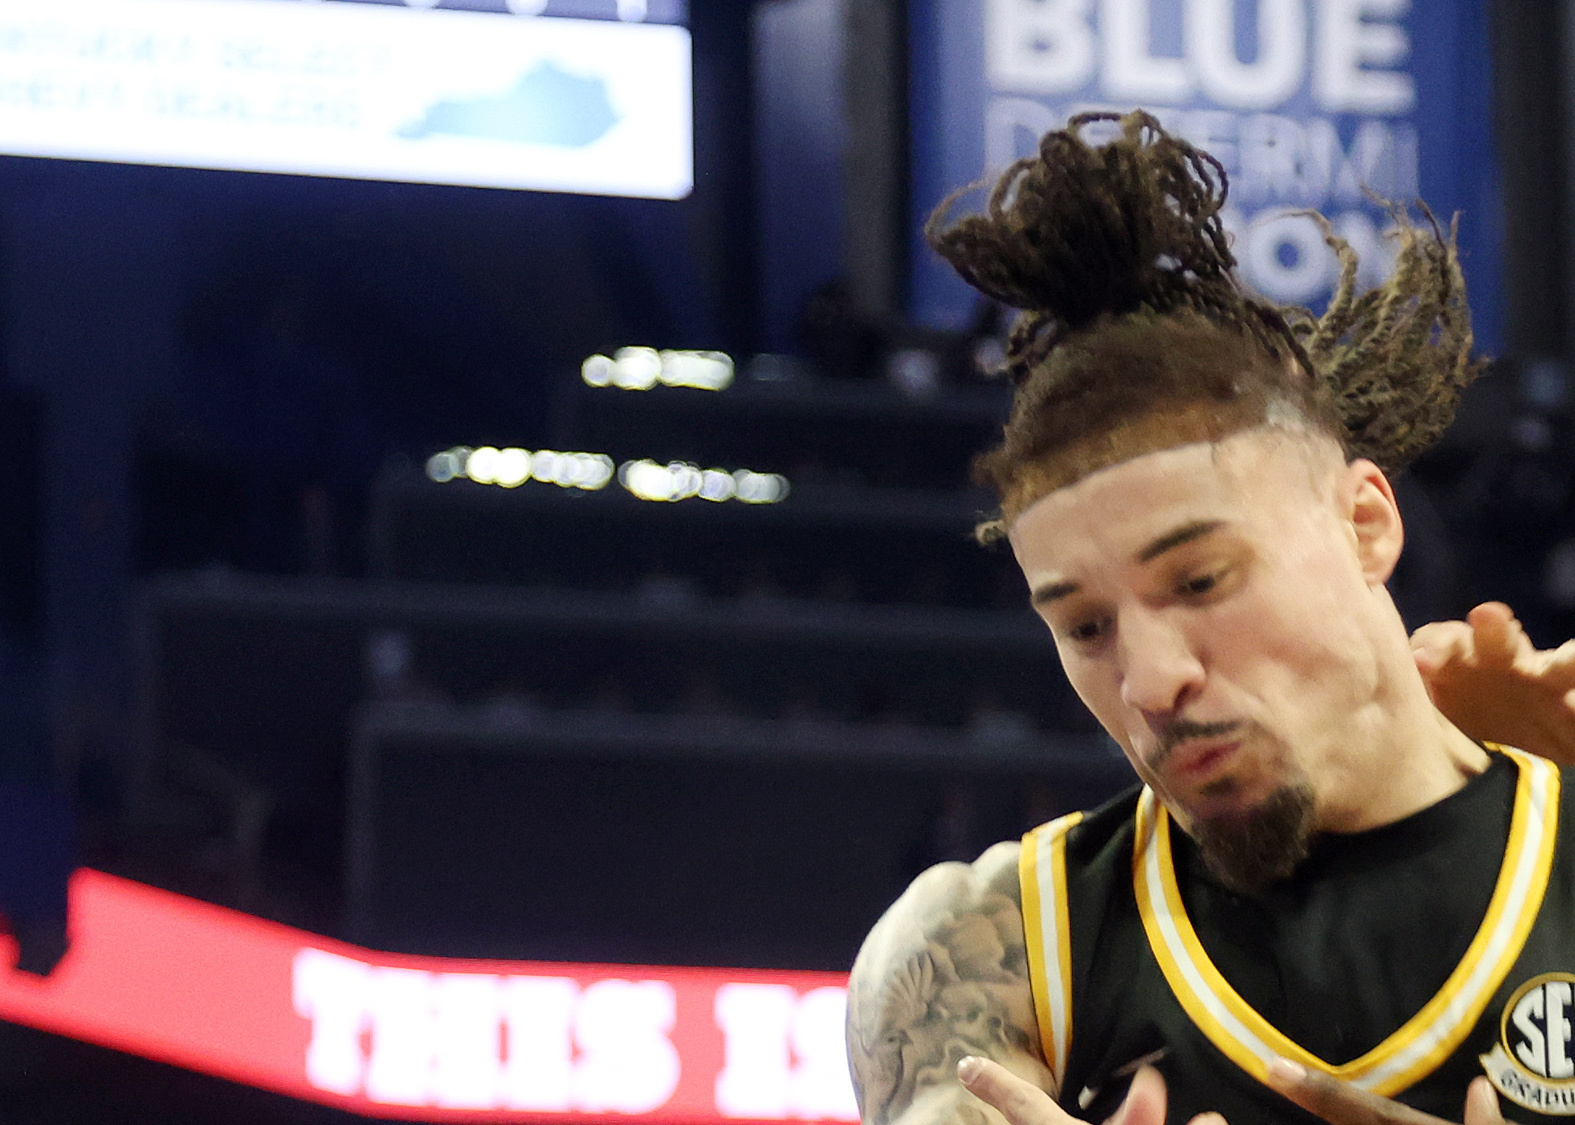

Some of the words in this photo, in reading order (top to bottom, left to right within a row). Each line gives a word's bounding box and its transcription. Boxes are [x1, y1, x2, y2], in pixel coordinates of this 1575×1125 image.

[986, 0, 1416, 112] BLUE
[293, 948, 682, 1115] THIS
[714, 981, 862, 1122] IS
